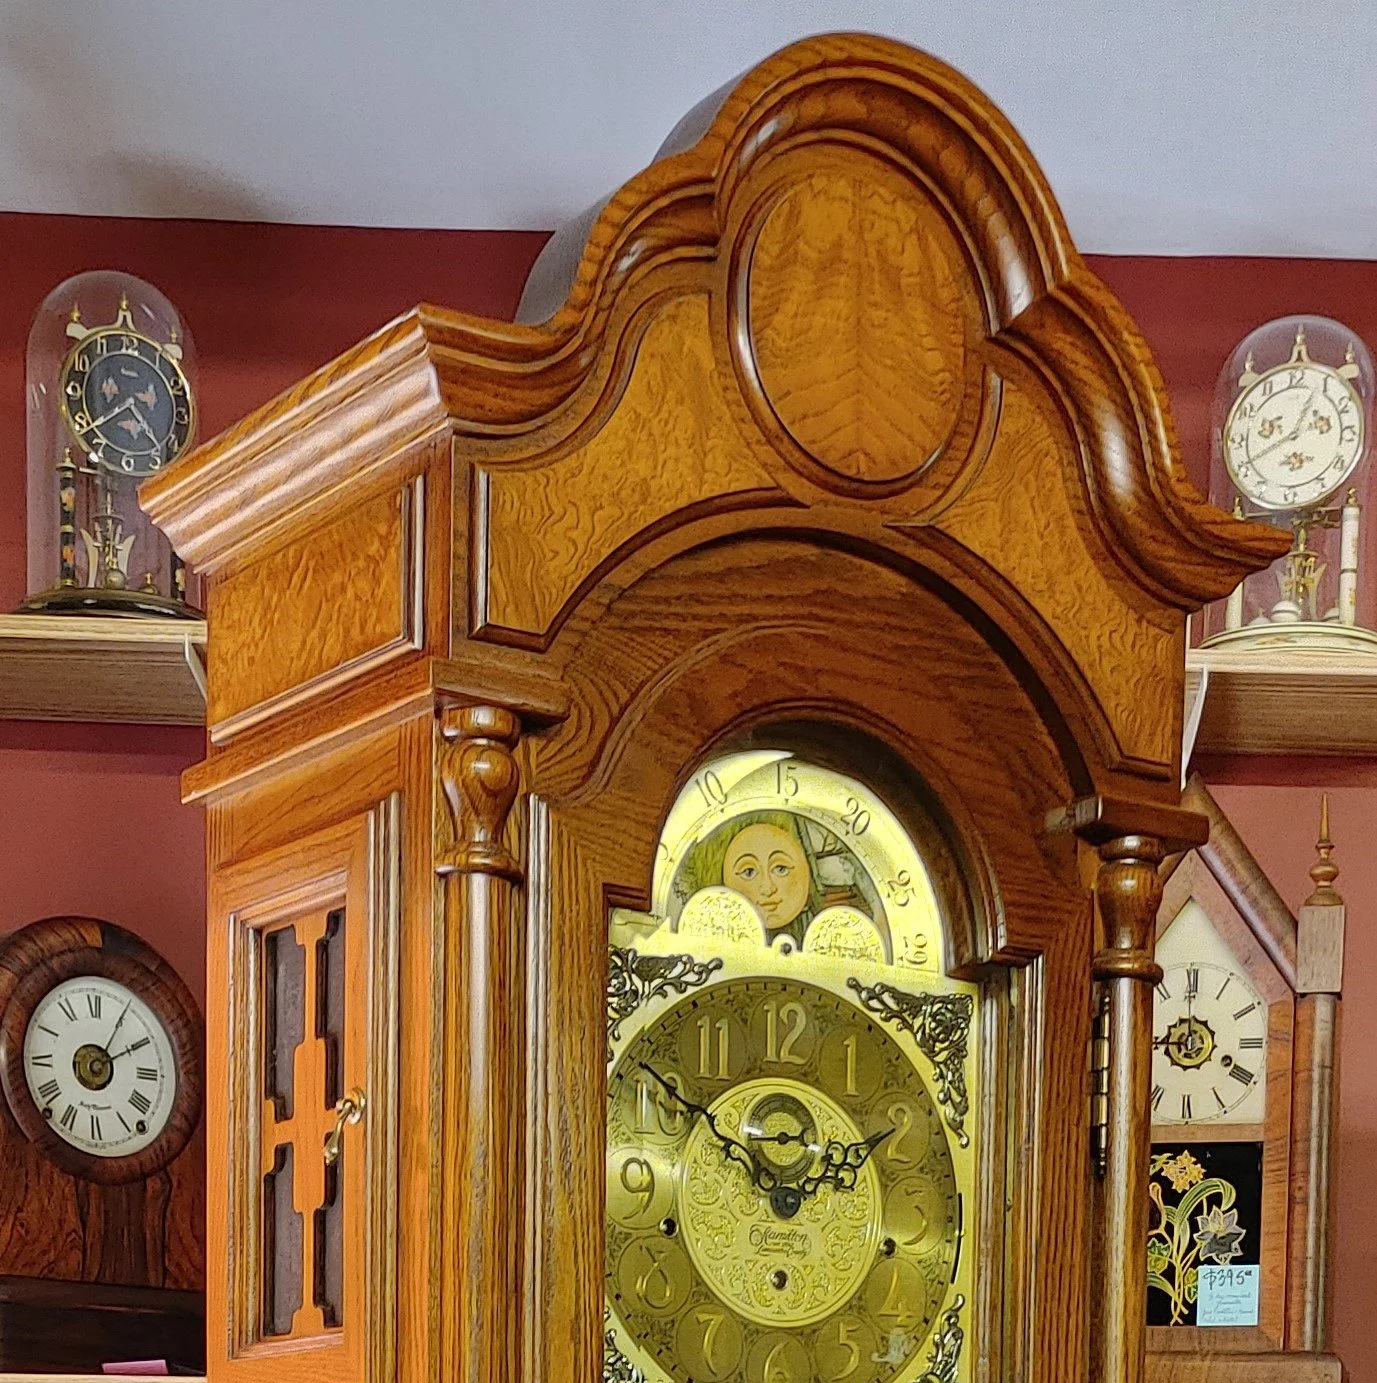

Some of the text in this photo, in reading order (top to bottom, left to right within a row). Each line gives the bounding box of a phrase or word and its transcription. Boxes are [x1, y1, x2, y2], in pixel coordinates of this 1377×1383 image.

[75, 352, 90, 372] 10
[121, 336, 139, 356] 12
[695, 770, 728, 807] 10
[776, 763, 799, 797] 15
[840, 797, 871, 837] 20
[887, 869, 917, 908] 25
[903, 933, 928, 965] 29
[697, 1015, 731, 1081] 11
[763, 1001, 808, 1065] 12
[843, 1034, 860, 1097] 1
[632, 1071, 686, 1136] 10
[887, 1103, 913, 1164] 2
[620, 1157, 655, 1220] 9
[634, 1245, 671, 1301] 8
[878, 1266, 912, 1328] 4
[695, 1313, 725, 1378] 7
[832, 1321, 860, 1382] 5
